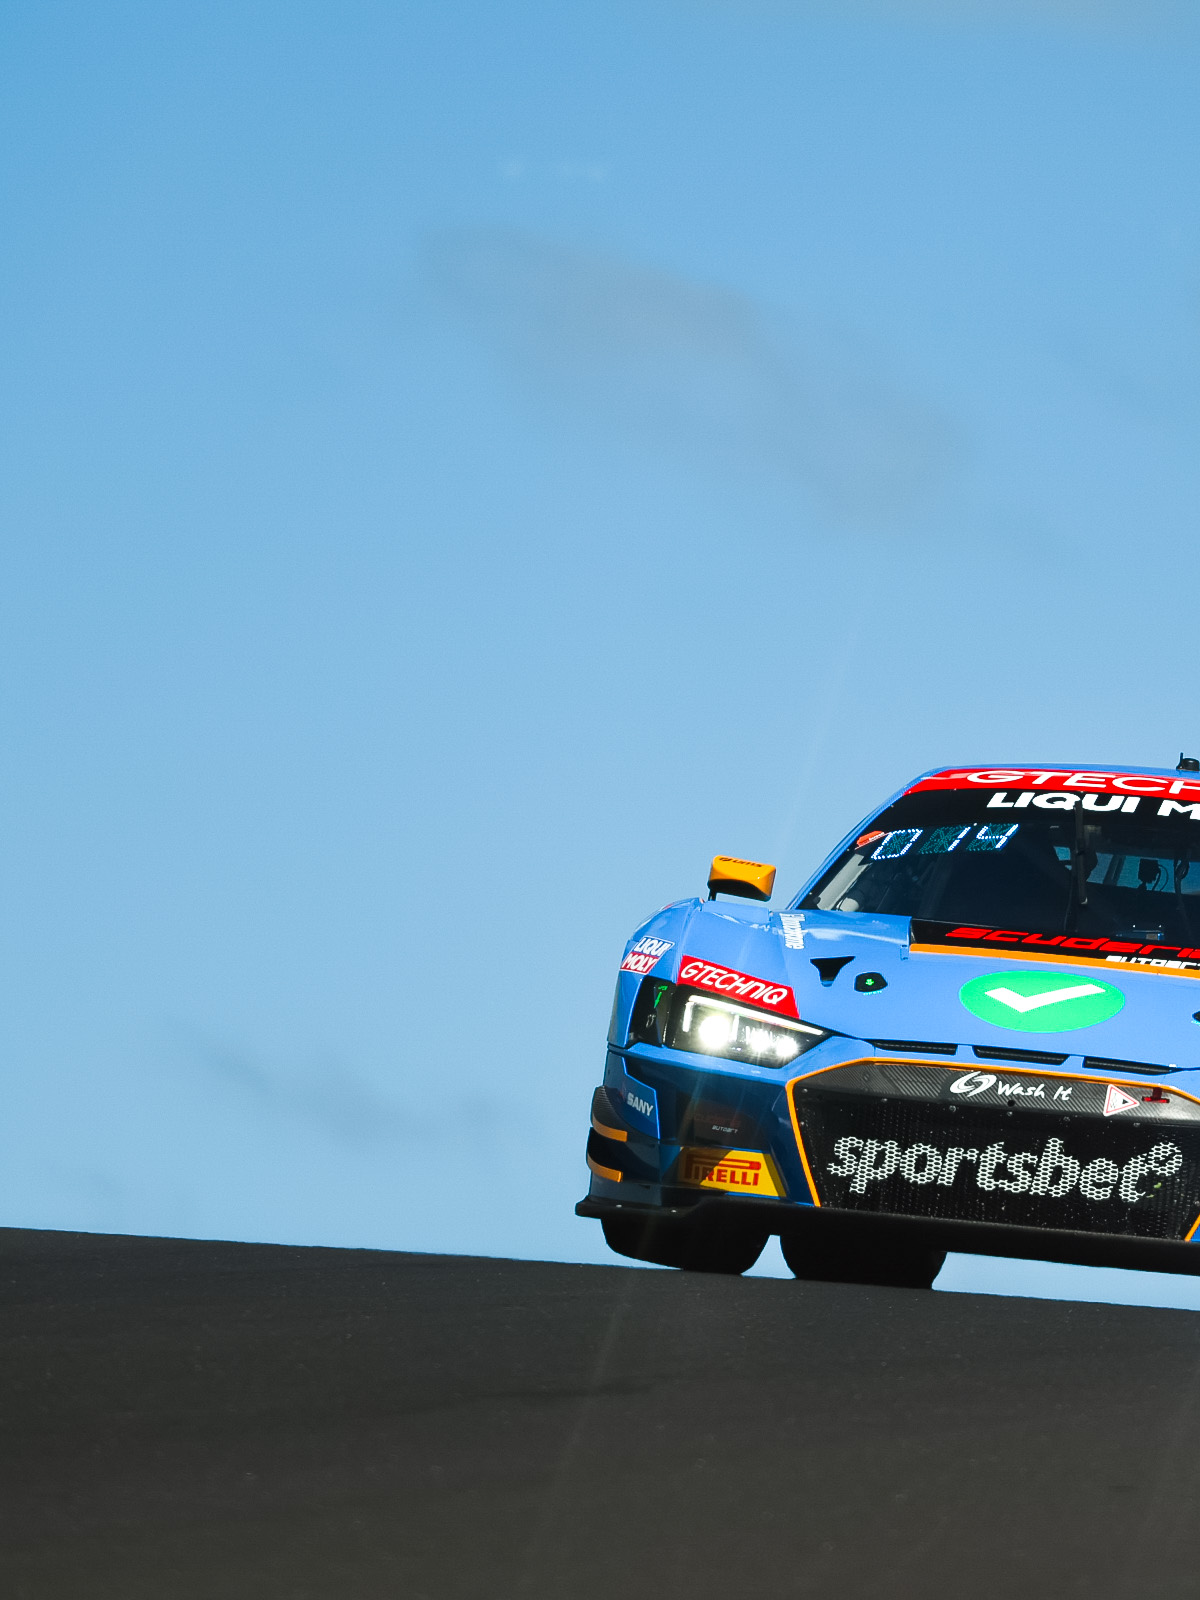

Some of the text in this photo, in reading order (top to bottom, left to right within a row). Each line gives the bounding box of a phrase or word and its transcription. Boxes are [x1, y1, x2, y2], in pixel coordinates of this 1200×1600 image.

[986, 791, 1142, 813] LIQUI
[633, 937, 672, 957] LIQUI
[621, 953, 660, 972] MOLY
[680, 961, 788, 1005] GTECHNIQ
[998, 1080, 1073, 1101] Wash It
[626, 1091, 654, 1117] SANY
[684, 1153, 761, 1187] PIRELLI
[827, 1136, 1150, 1203] sportsbet
